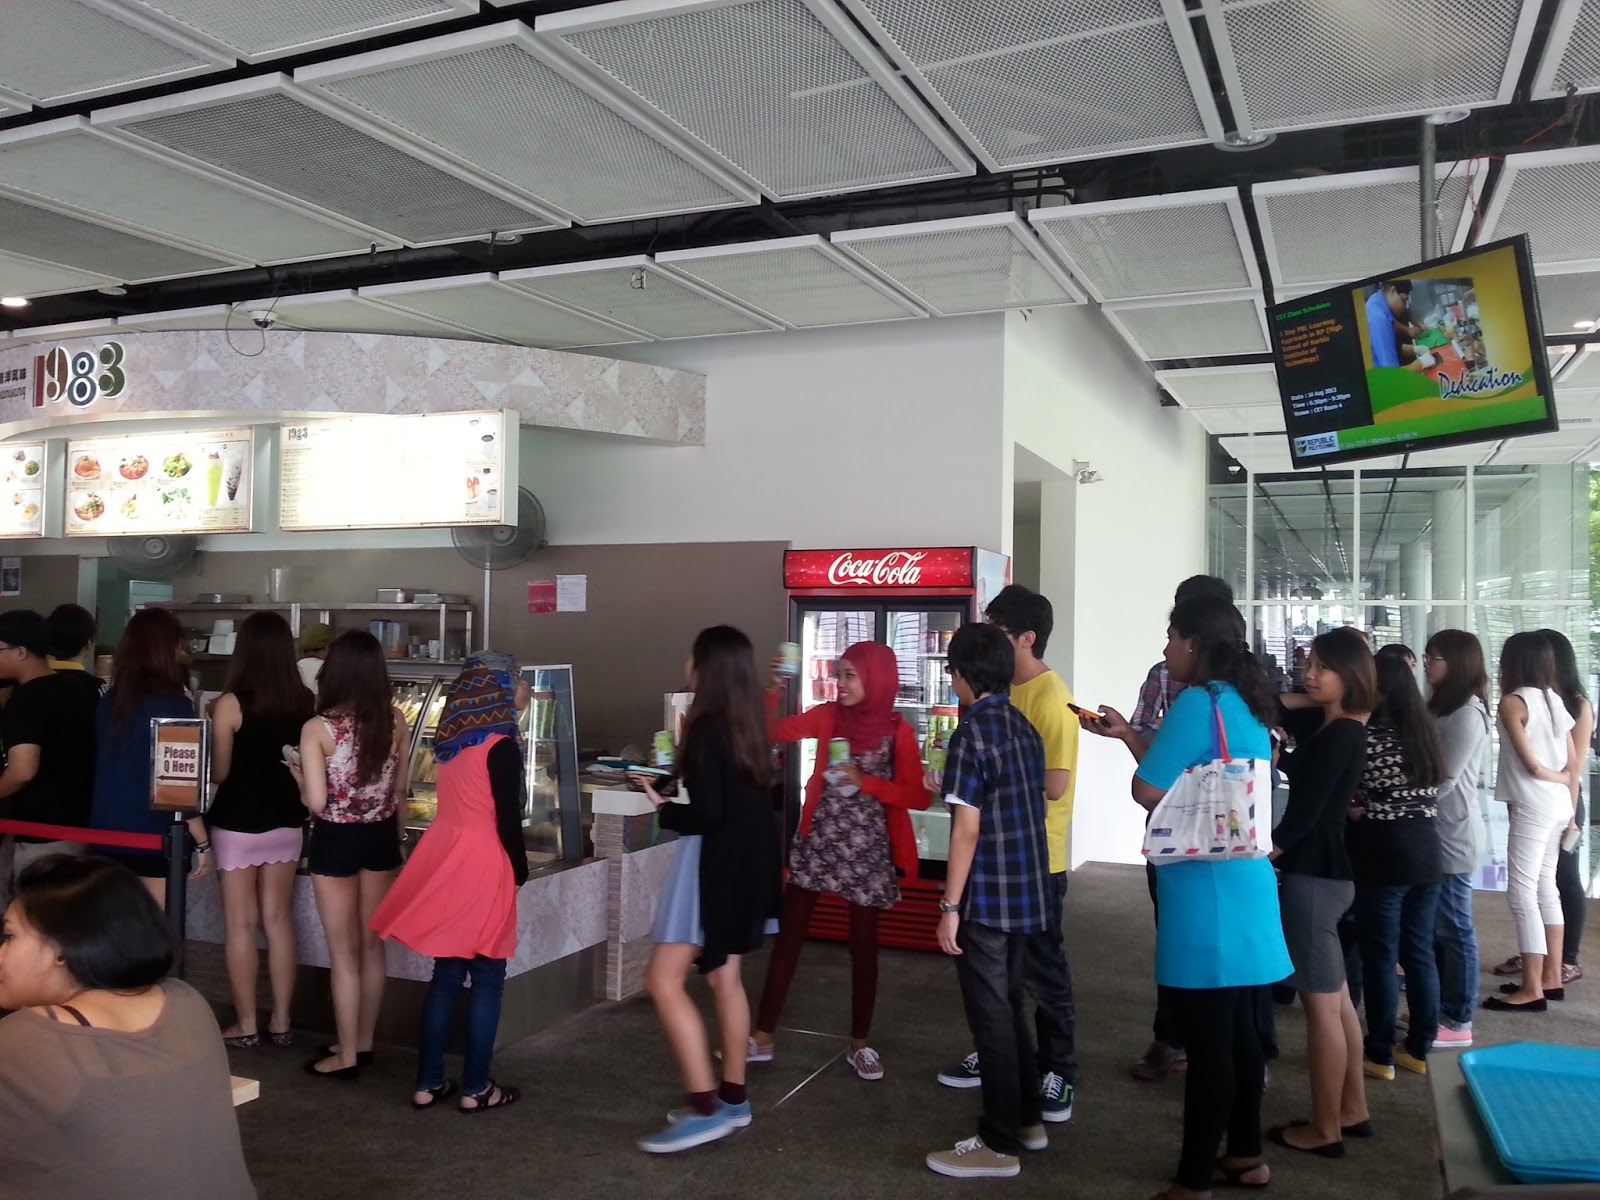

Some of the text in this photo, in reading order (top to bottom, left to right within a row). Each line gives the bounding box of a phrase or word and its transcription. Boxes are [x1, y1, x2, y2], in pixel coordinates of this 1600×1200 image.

[1276, 301, 1331, 321] CET Class Schedules
[1284, 329, 1296, 337] Day
[1309, 319, 1336, 330] Learning
[1281, 333, 1309, 345] Approach
[1282, 342, 1301, 353] School
[33, 341, 126, 408] 1983
[1438, 367, 1523, 399] Dedication
[1293, 409, 1310, 417] Venue
[1307, 435, 1335, 446] REPUBLIC
[1308, 443, 1336, 452] POLYTECHNIC
[827, 551, 928, 585] Coca-Cola
[164, 746, 196, 759] Please
[164, 760, 195, 773] Q Here
